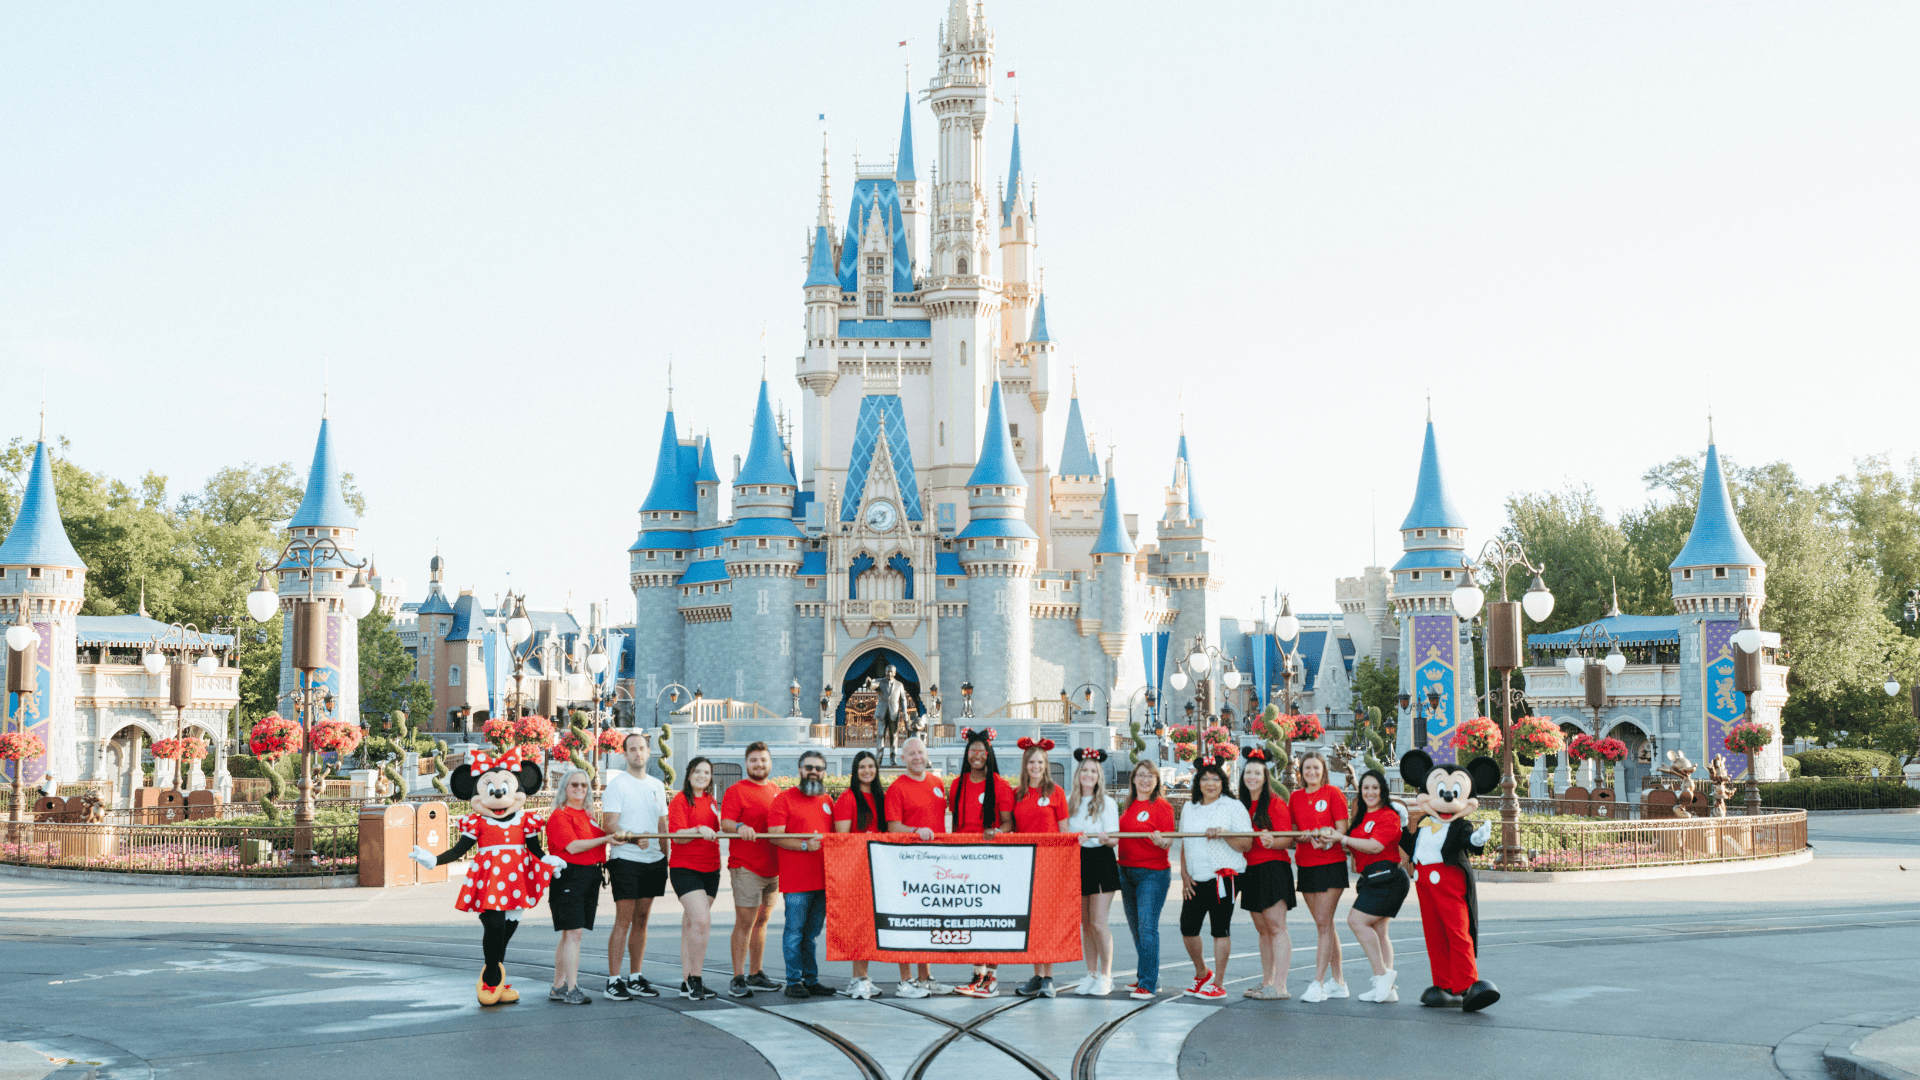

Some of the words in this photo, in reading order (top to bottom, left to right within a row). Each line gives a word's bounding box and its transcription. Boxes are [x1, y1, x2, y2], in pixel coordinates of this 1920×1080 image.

[915, 850, 941, 862] Disney
[931, 865, 970, 883] Disney
[921, 897, 983, 908] CAMPUS
[887, 917, 942, 928] TEACHERS
[943, 918, 1017, 928] CELEBRATION
[931, 930, 972, 944] 2025
